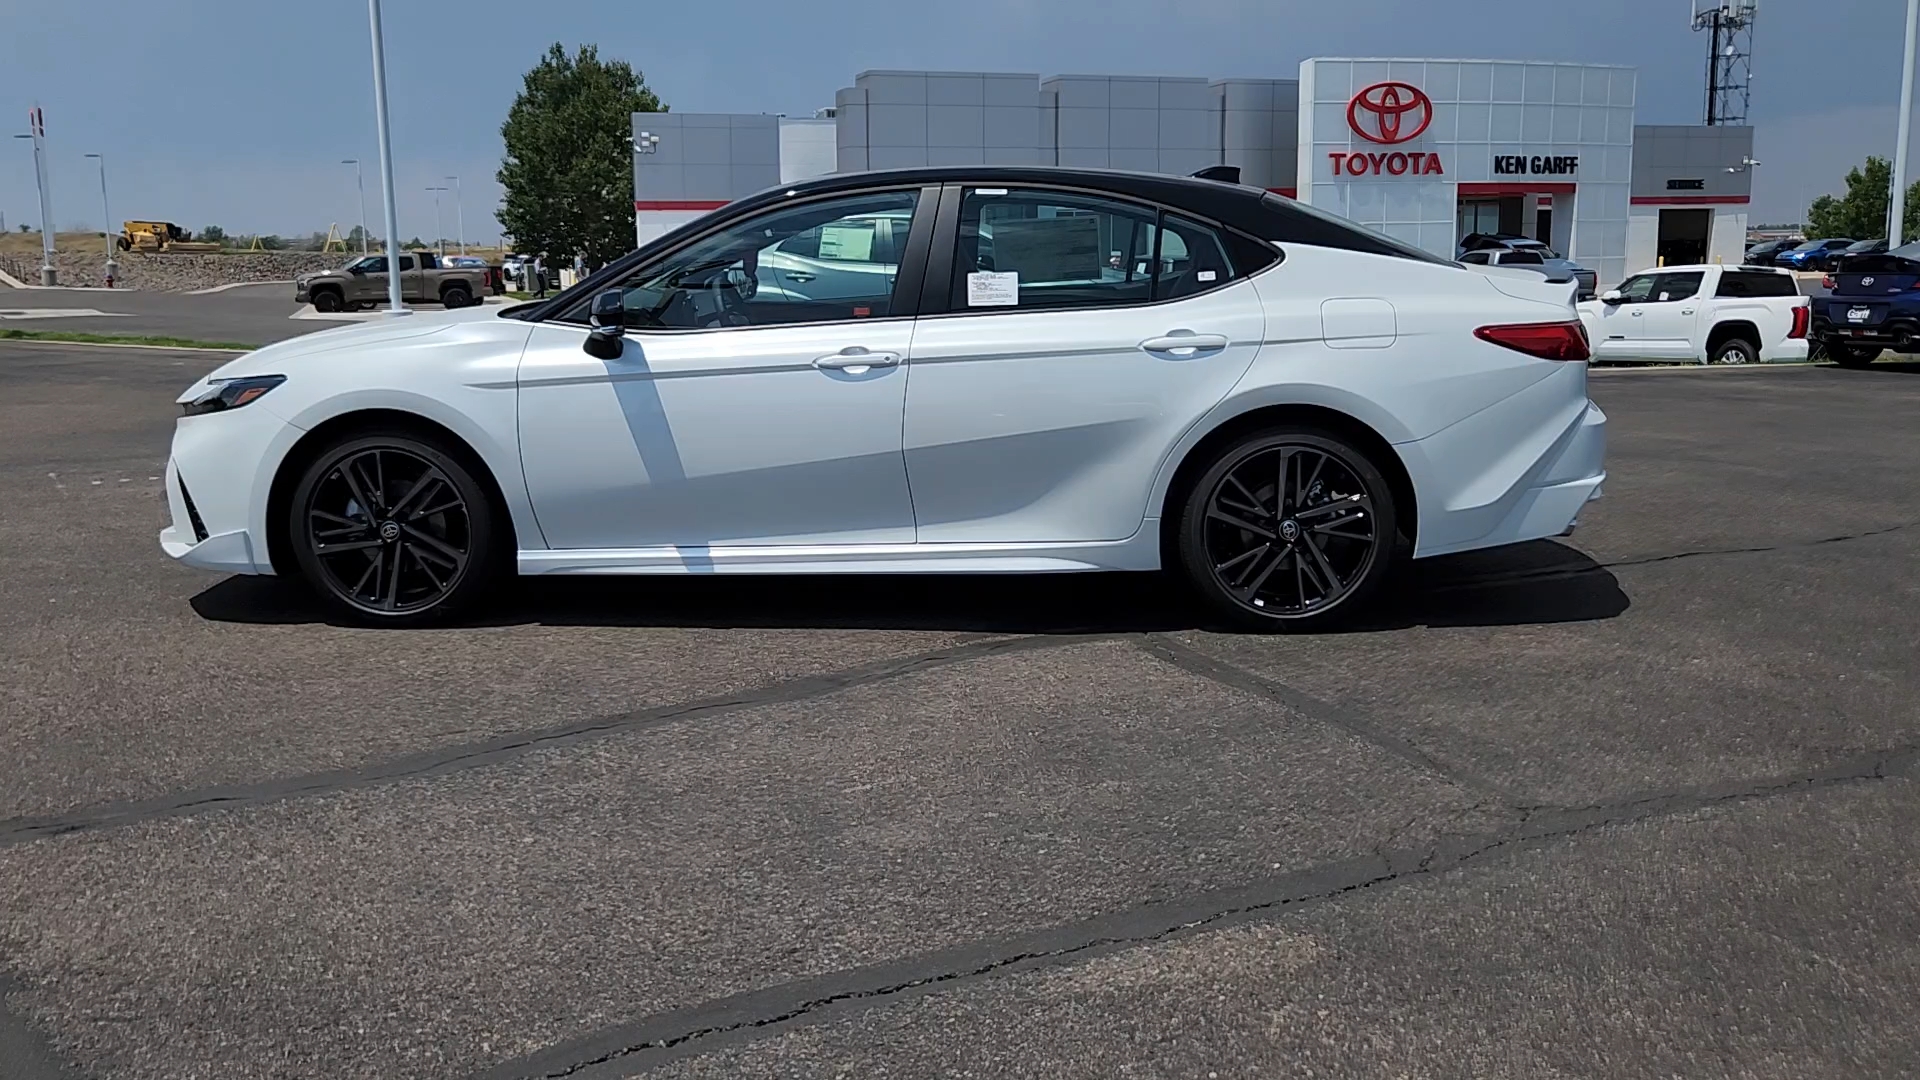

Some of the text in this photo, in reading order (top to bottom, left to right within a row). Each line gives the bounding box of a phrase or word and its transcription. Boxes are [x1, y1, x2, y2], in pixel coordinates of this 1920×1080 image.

[1328, 152, 1444, 176] TOYOTA
[1494, 155, 1578, 175] KEN GARFF
[1666, 179, 1705, 190] SECE
[1847, 309, 1870, 319] Garff
